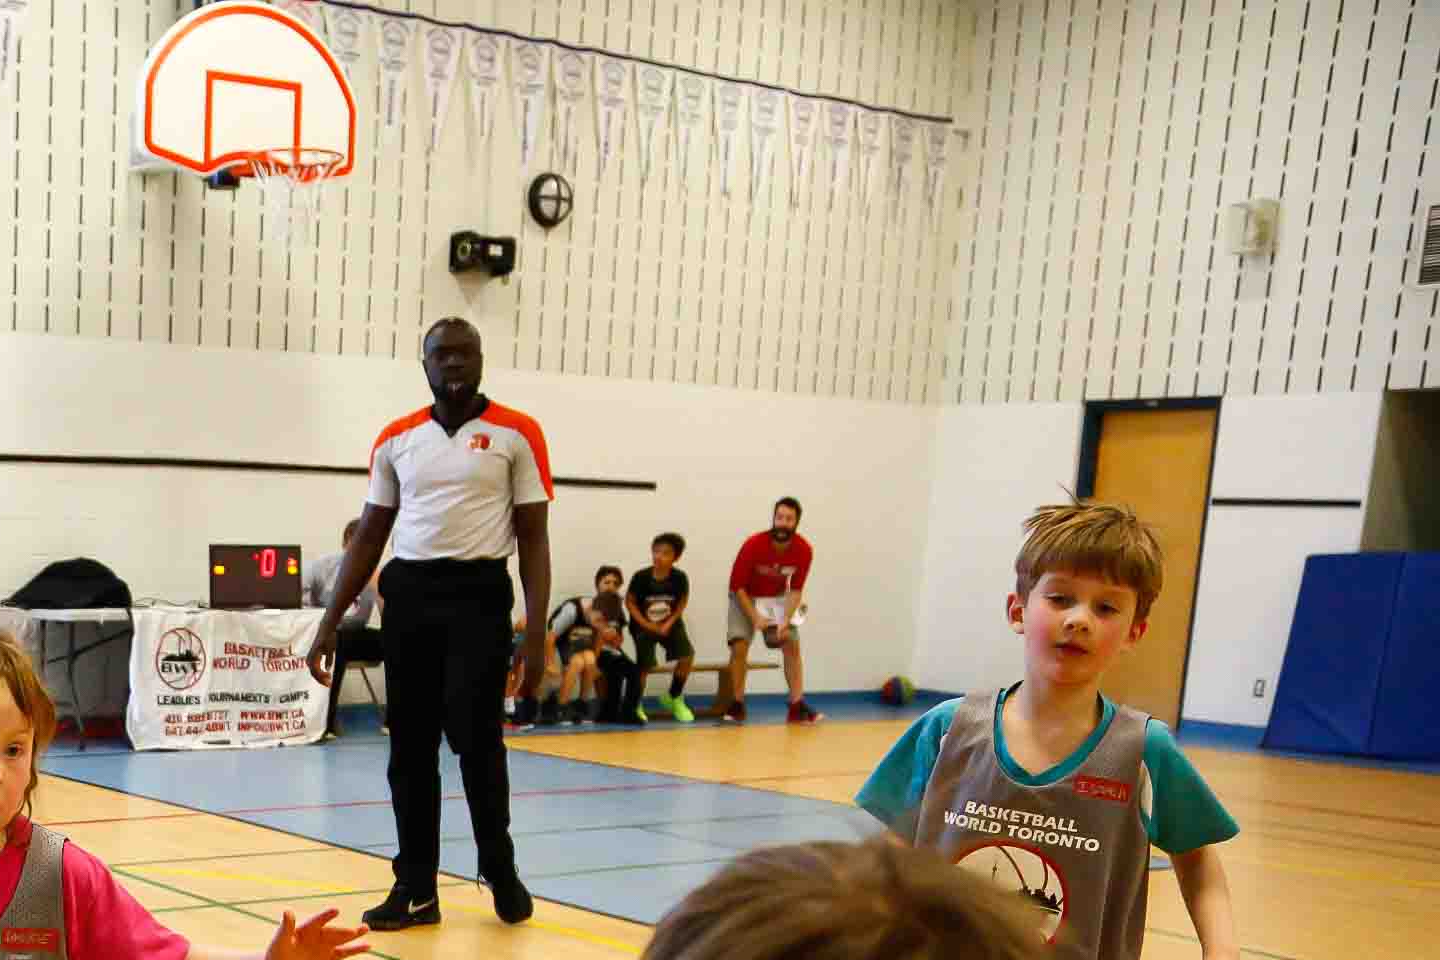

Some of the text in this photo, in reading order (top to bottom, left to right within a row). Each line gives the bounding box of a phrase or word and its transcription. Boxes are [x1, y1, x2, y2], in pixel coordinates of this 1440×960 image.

[213, 657, 309, 672] WORLD TORONT
[945, 810, 1100, 852] WORLD TORONTO
[965, 800, 1078, 832] BASKETBALL
